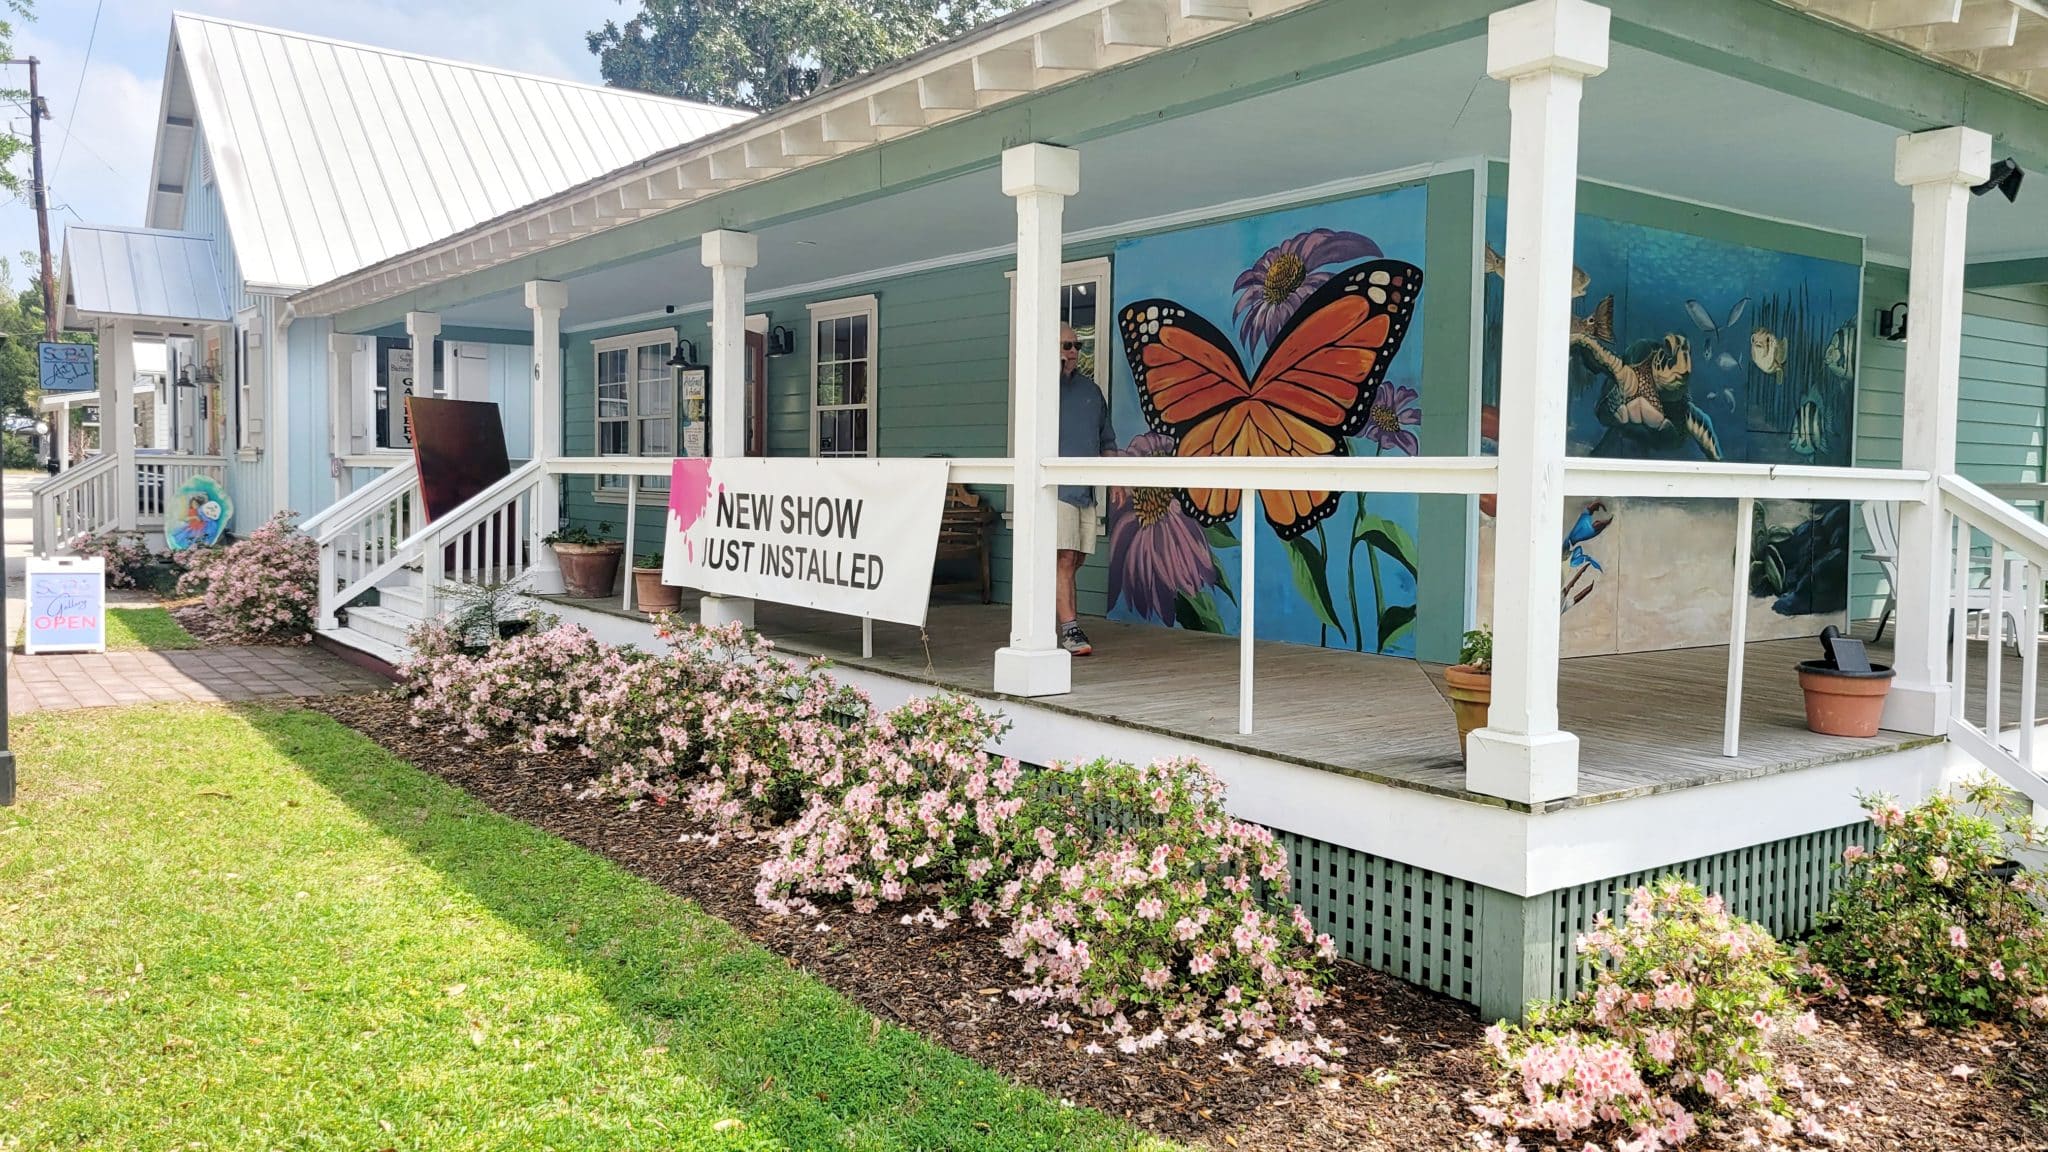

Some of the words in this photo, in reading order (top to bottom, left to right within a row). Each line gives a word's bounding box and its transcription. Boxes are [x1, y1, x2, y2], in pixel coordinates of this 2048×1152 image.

[534, 362, 540, 381] 6
[716, 492, 774, 531] NEW
[780, 495, 864, 540] SHOW
[701, 537, 755, 573] JUST
[759, 543, 884, 591] INSTALLED
[34, 615, 97, 630] OPEN
